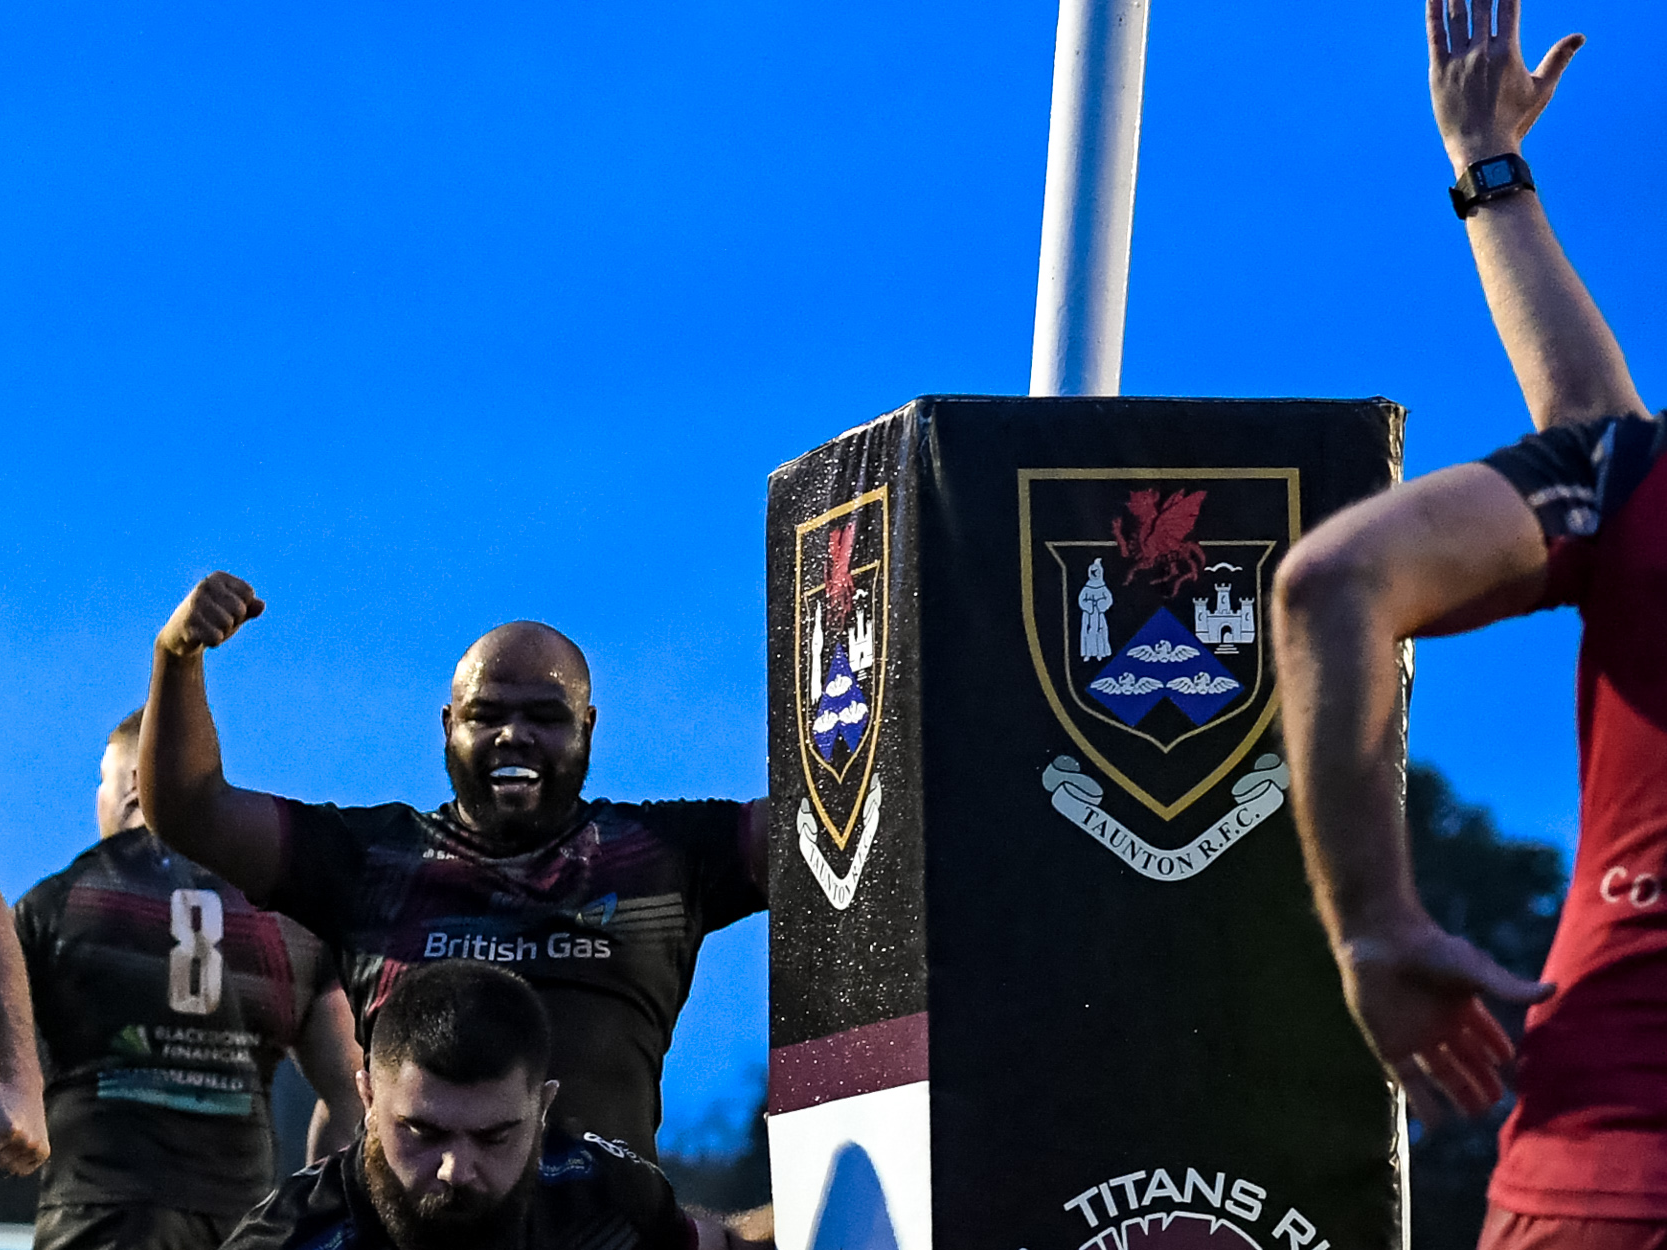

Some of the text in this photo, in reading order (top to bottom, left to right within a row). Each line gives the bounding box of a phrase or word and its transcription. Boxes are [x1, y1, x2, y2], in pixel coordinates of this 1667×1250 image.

[1080, 806, 1261, 876] TAUNTON R.F.C.
[168, 888, 224, 1015] 8
[423, 932, 612, 962] British Gas
[1063, 1166, 1267, 1231] TITANS
